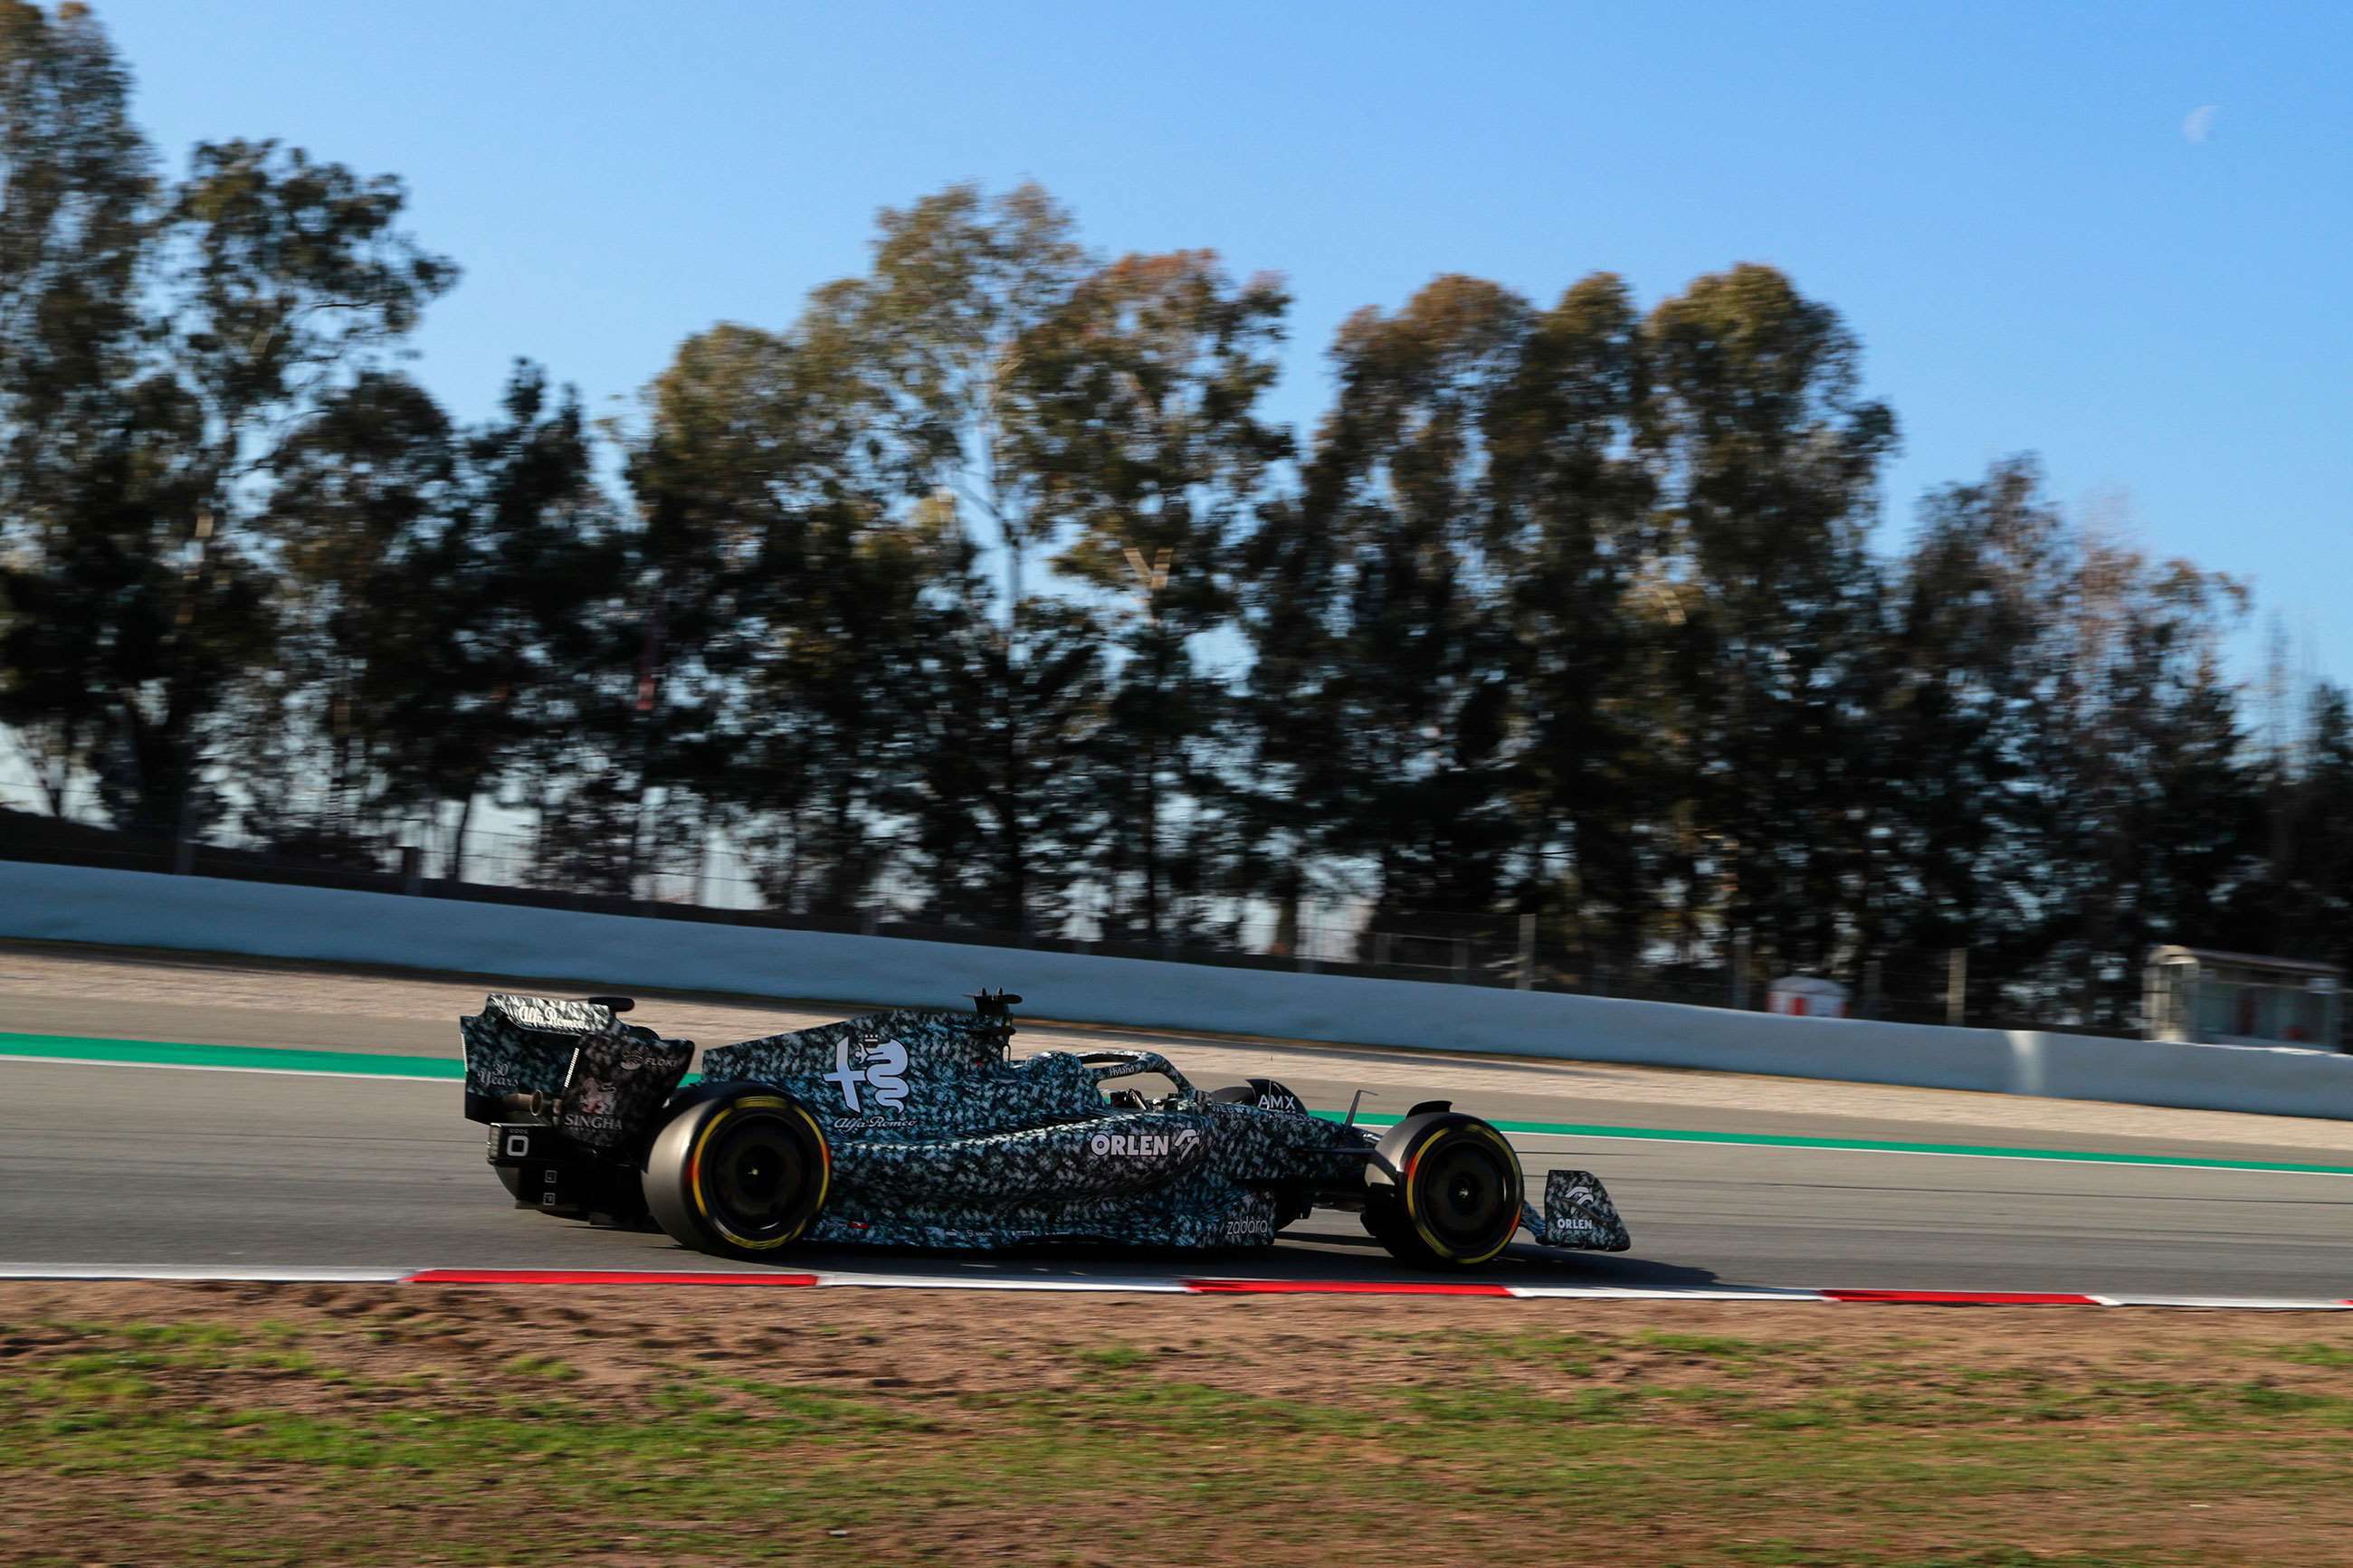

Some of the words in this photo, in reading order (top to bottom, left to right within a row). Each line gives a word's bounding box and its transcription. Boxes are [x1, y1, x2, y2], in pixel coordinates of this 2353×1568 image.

[1258, 1093, 1295, 1110] AMX
[564, 1114, 623, 1130] SINGHA
[834, 1117, 866, 1134] Alfa
[868, 1116, 918, 1127] Romeo
[1091, 1134, 1169, 1156] ORLEN
[1227, 1215, 1268, 1236] zadara
[1558, 1219, 1593, 1230] ORLEN
